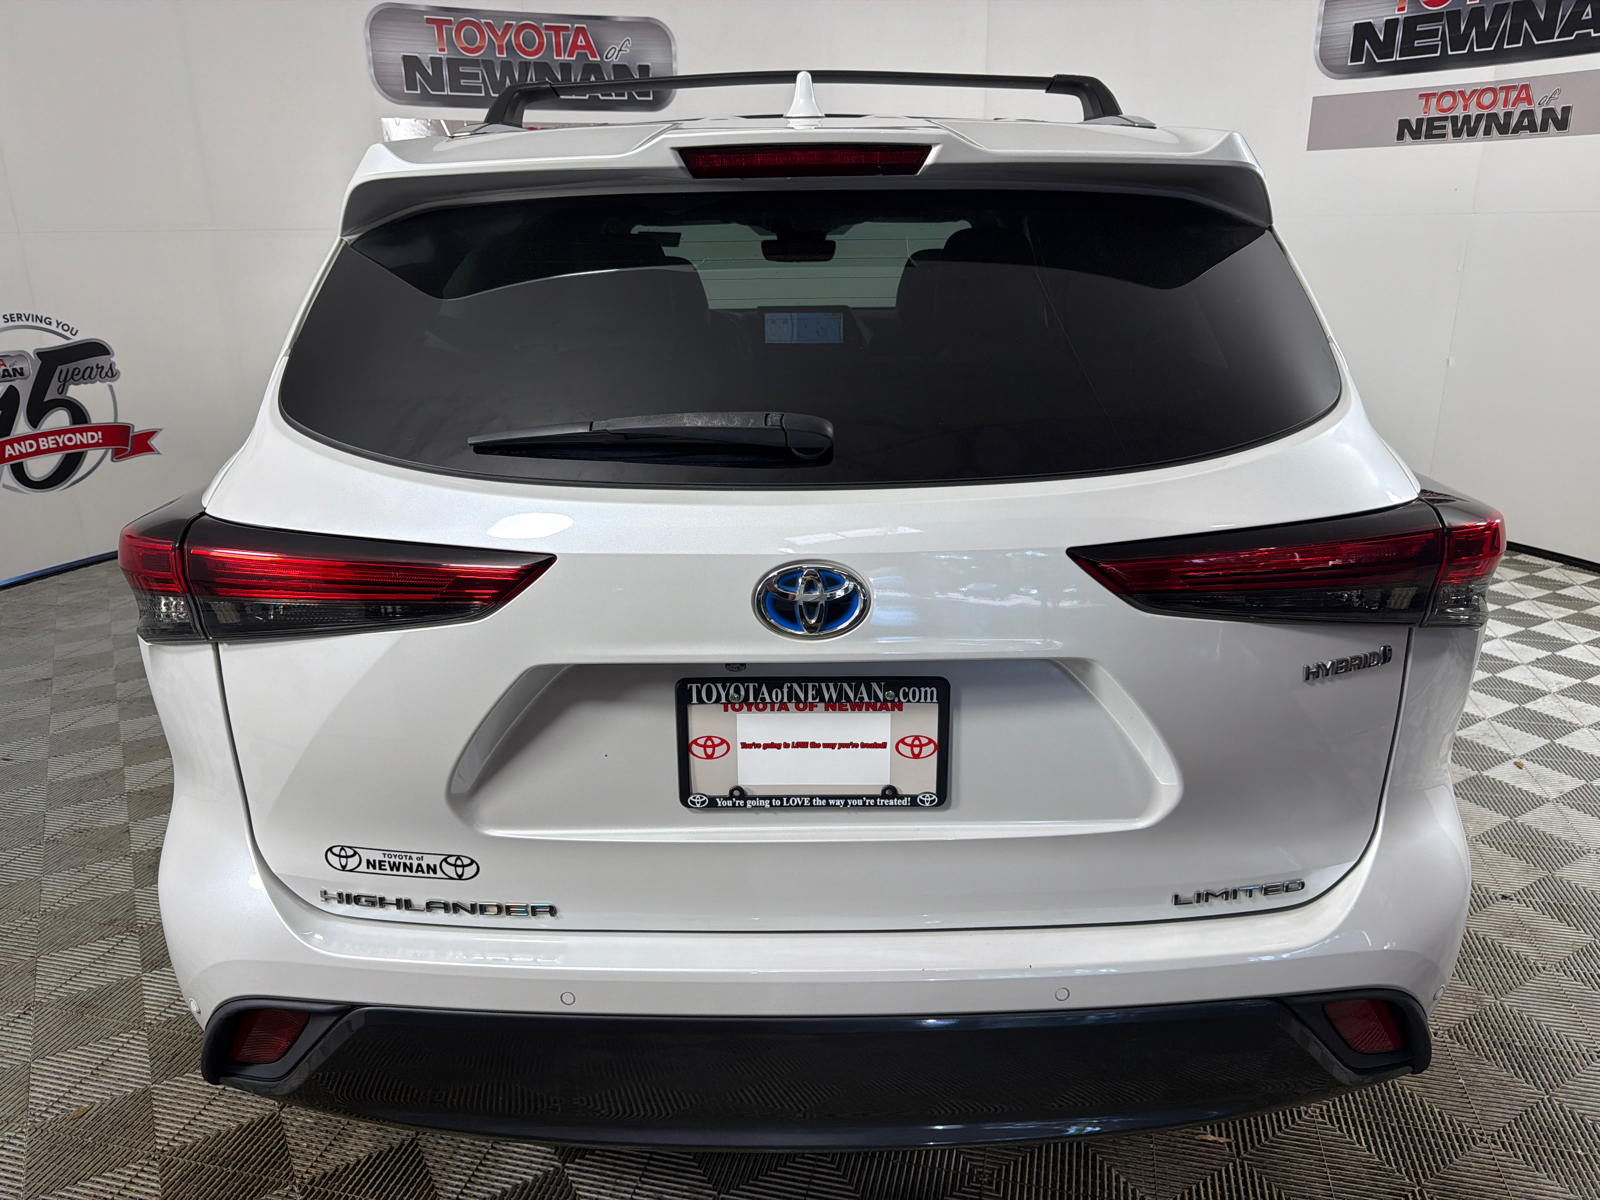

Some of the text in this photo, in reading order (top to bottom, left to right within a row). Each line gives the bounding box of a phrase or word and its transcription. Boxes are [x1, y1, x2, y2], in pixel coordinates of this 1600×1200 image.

[424, 16, 631, 61] TOYOTA of
[1418, 82, 1561, 116] TOYOTA of
[1395, 104, 1573, 142] NEWNAN
[2, 313, 79, 336] SERVING YOU
[57, 362, 118, 395] years
[4, 431, 103, 458] AND BEYOND!
[1302, 651, 1381, 682] HYBRID
[722, 702, 904, 712] TOYOTA OF NEWNAN
[822, 742, 836, 750] way
[716, 797, 911, 808] You're going to LOVE the way you're treated!
[366, 858, 438, 875] NEWNAN
[382, 852, 414, 861] TOYOTA
[319, 887, 558, 917] HIGHLANDER
[1172, 879, 1306, 905] LIMITED
